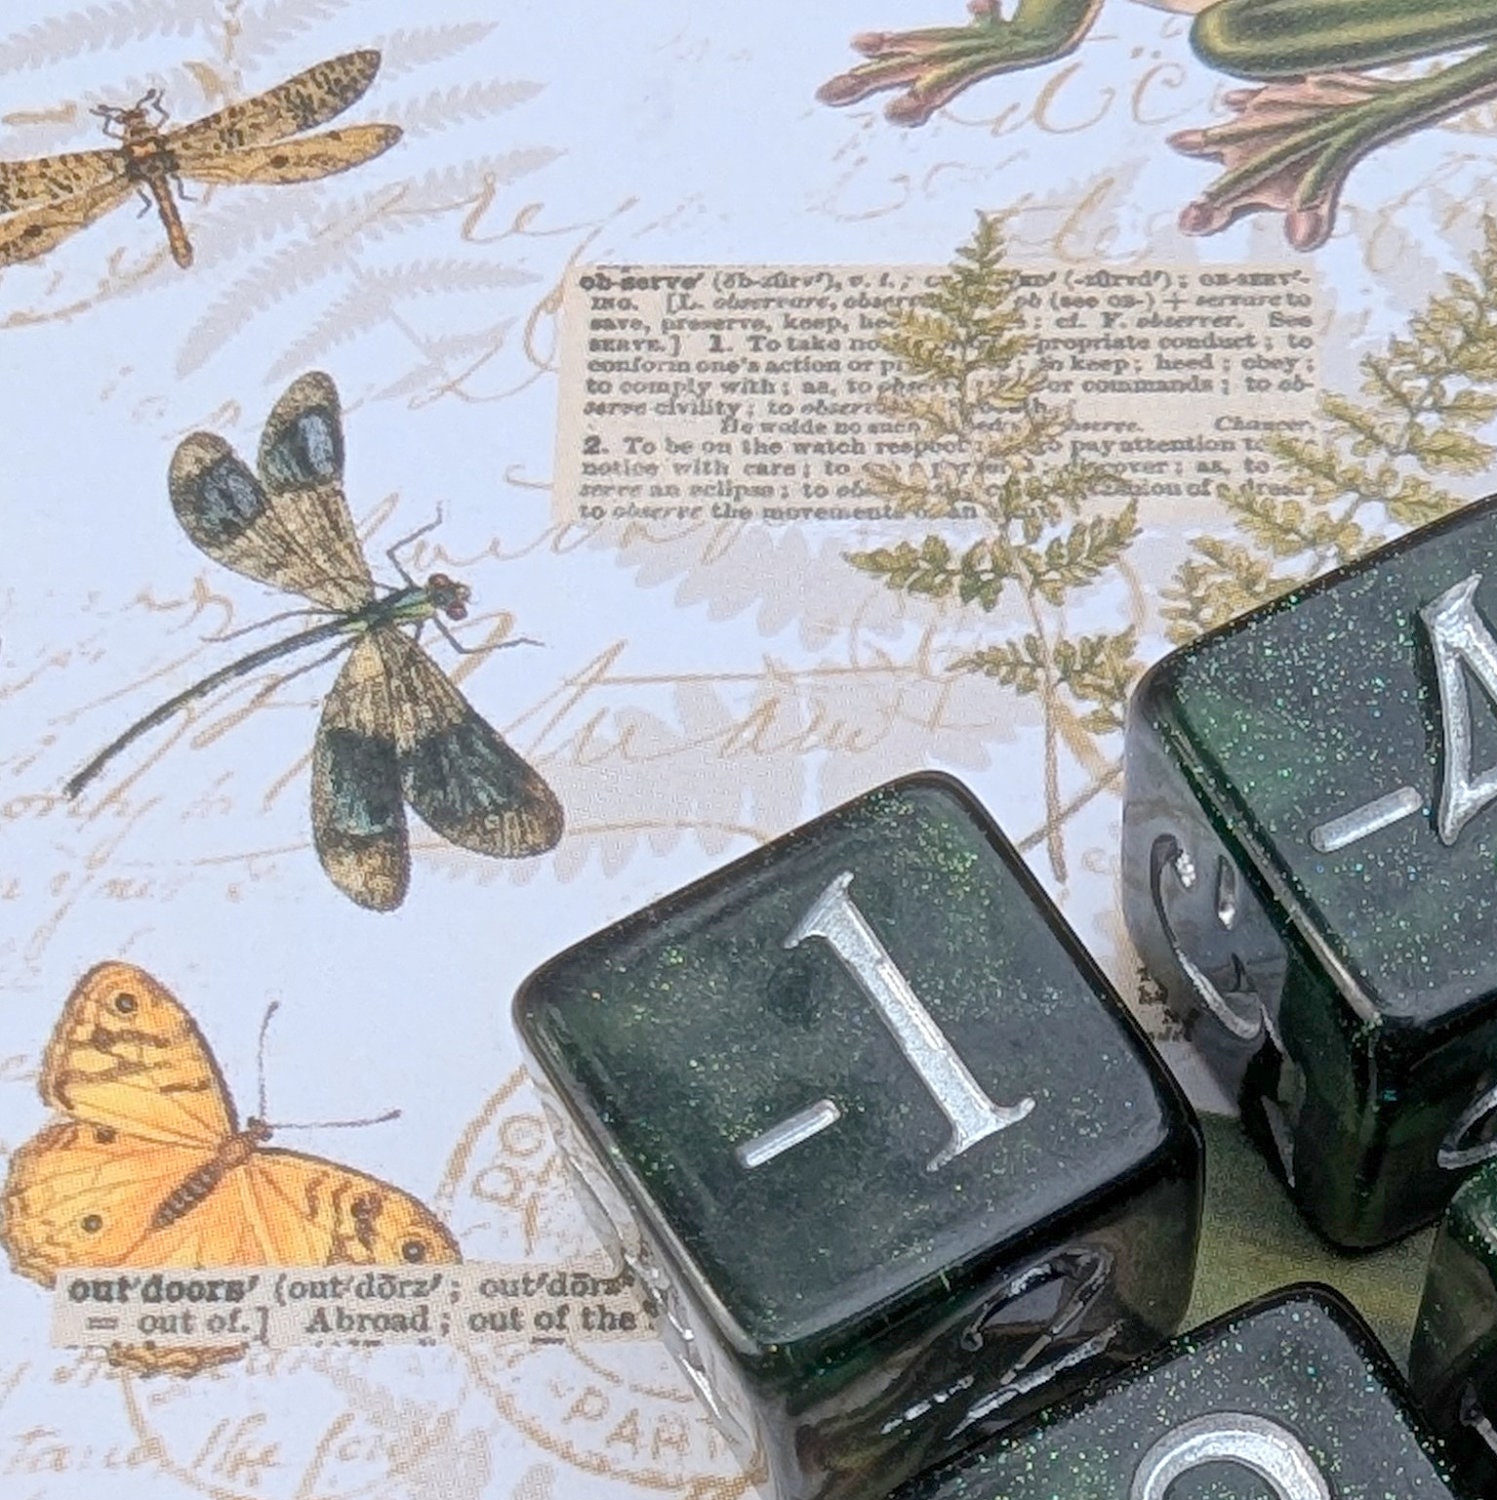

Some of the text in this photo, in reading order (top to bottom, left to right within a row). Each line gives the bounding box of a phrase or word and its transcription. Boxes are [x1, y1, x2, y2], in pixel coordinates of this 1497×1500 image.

[1286, 292, 1312, 308] to
[590, 316, 651, 336] save,
[660, 317, 773, 336] preserve,
[781, 312, 851, 336] keep,
[1268, 311, 1314, 328] See
[746, 335, 782, 352] To
[786, 333, 842, 352] take
[1287, 333, 1314, 349] to
[586, 355, 874, 375] conform one's action or
[586, 378, 610, 395] to
[617, 379, 713, 401] comply
[849, 379, 872, 395] to
[1246, 377, 1270, 394] to
[583, 400, 795, 416] serve to
[834, 420, 861, 435] no
[582, 434, 1237, 459] 2. To be on the watch pay attention
[580, 461, 660, 477] notice
[672, 459, 730, 476] with
[824, 461, 851, 475] to
[578, 483, 828, 498] serve an to
[579, 504, 607, 520] to
[611, 503, 704, 520] observe
[711, 502, 753, 520] the
[736, 871, 1037, 1172] -1
[136, 1308, 196, 1335] out
[468, 1306, 525, 1333] out
[533, 1303, 570, 1332] of
[581, 1303, 637, 1333] the
